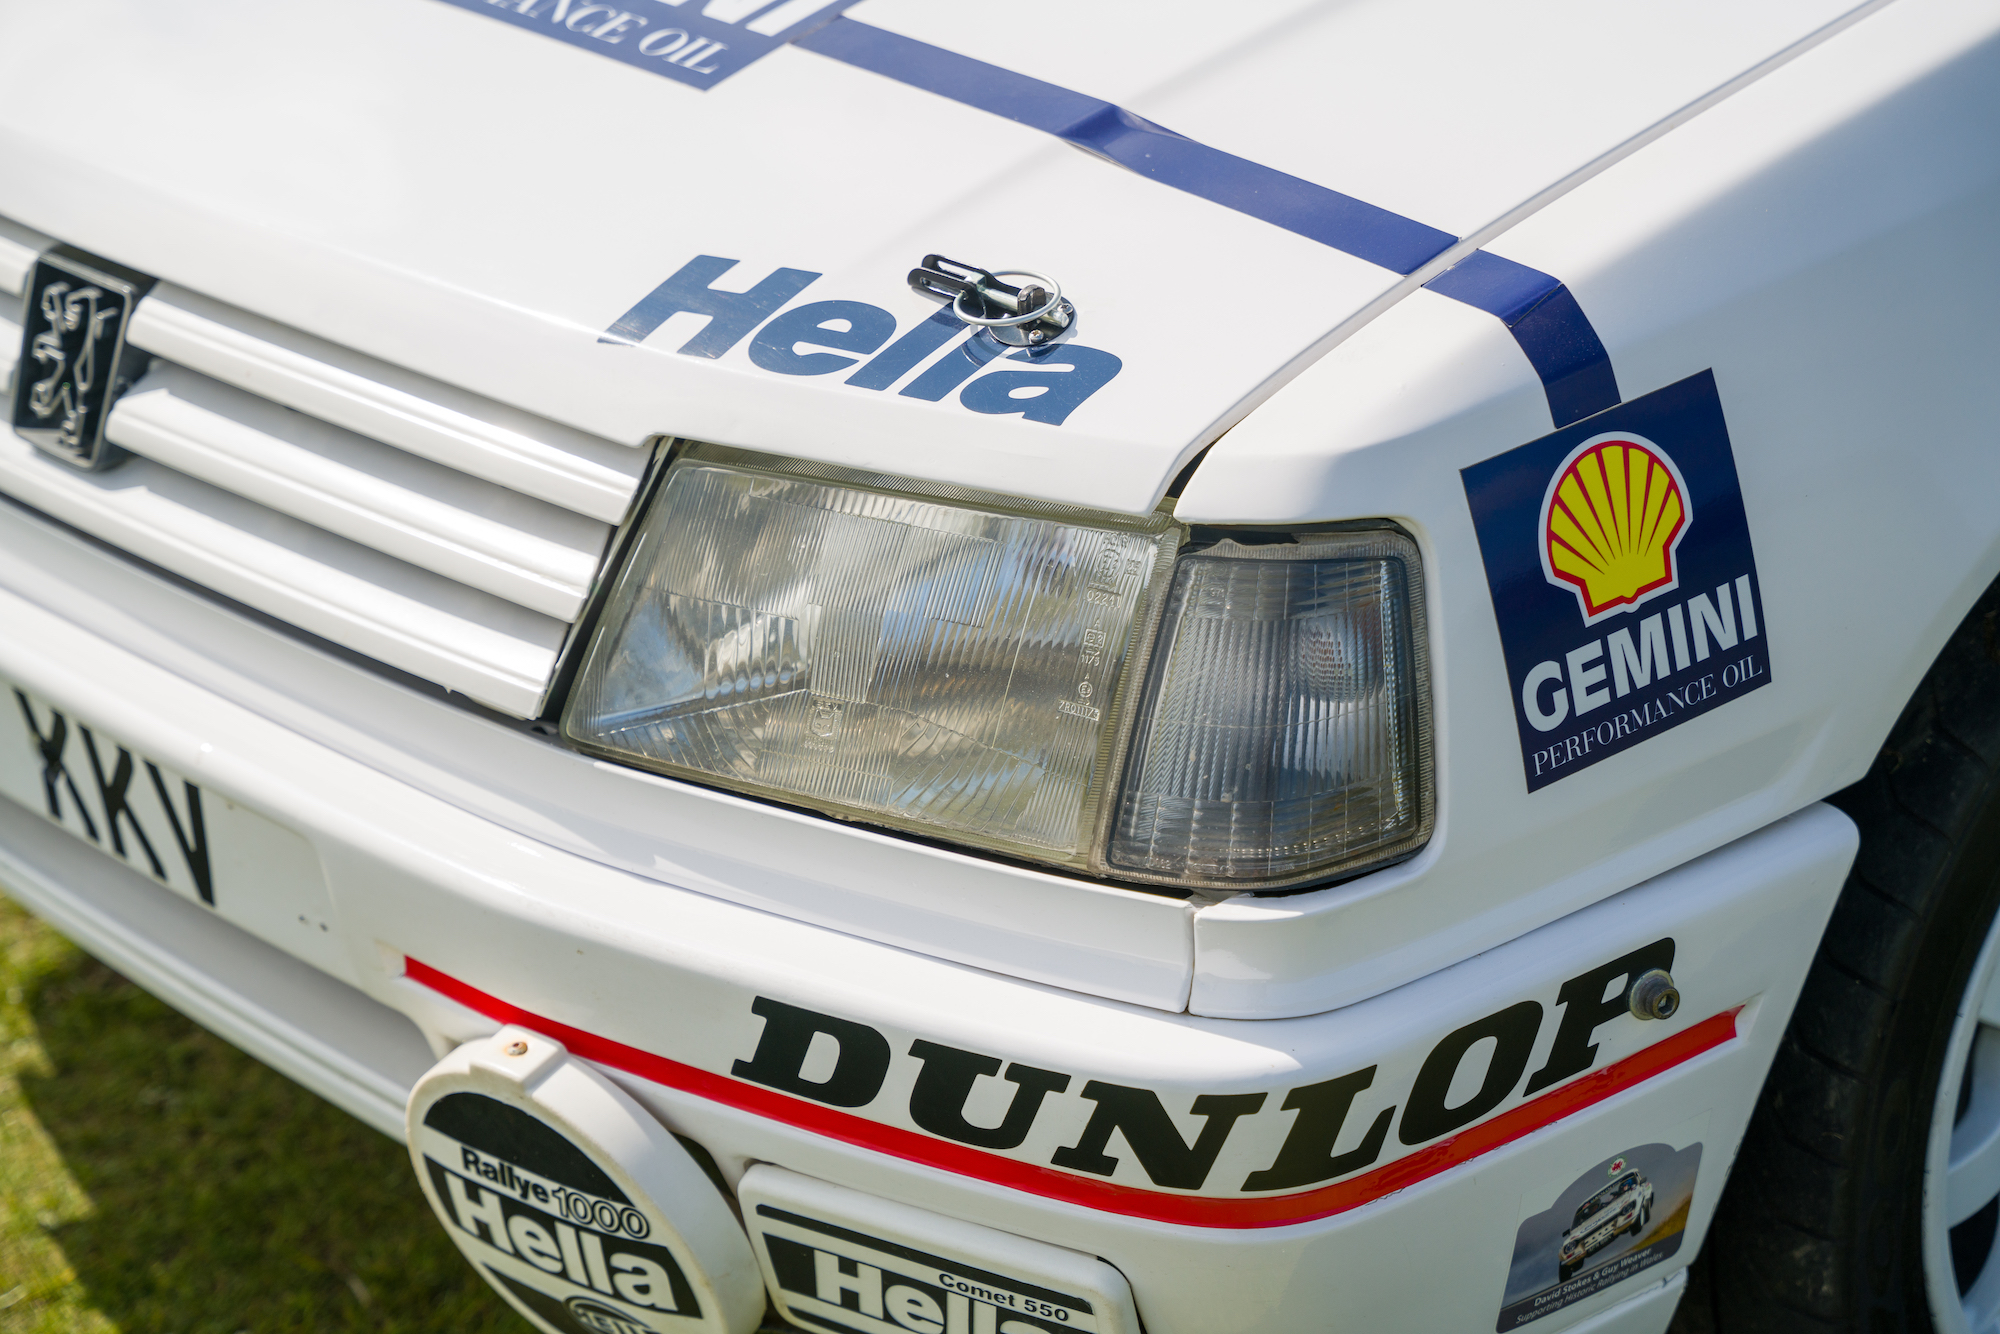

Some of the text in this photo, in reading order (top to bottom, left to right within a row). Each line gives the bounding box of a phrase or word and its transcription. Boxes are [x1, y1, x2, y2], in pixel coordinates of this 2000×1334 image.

[638, 27, 730, 74] OIL
[597, 254, 1123, 427] Hella
[1522, 573, 1758, 732] GEMINI
[1532, 655, 1763, 777] PERFORMANCE OIL
[730, 936, 1676, 1192] DUNLOP
[443, 1170, 679, 1312] Hella
[460, 1145, 650, 1240] Rallye 1000
[939, 1273, 1069, 1322] Comet 550
[1515, 1299, 1563, 1324] Supporting
[1564, 1285, 1596, 1304] Historic
[1597, 1267, 1630, 1288] Rallying
[1534, 1248, 1652, 1307] David Stokes & Guy Weaver
